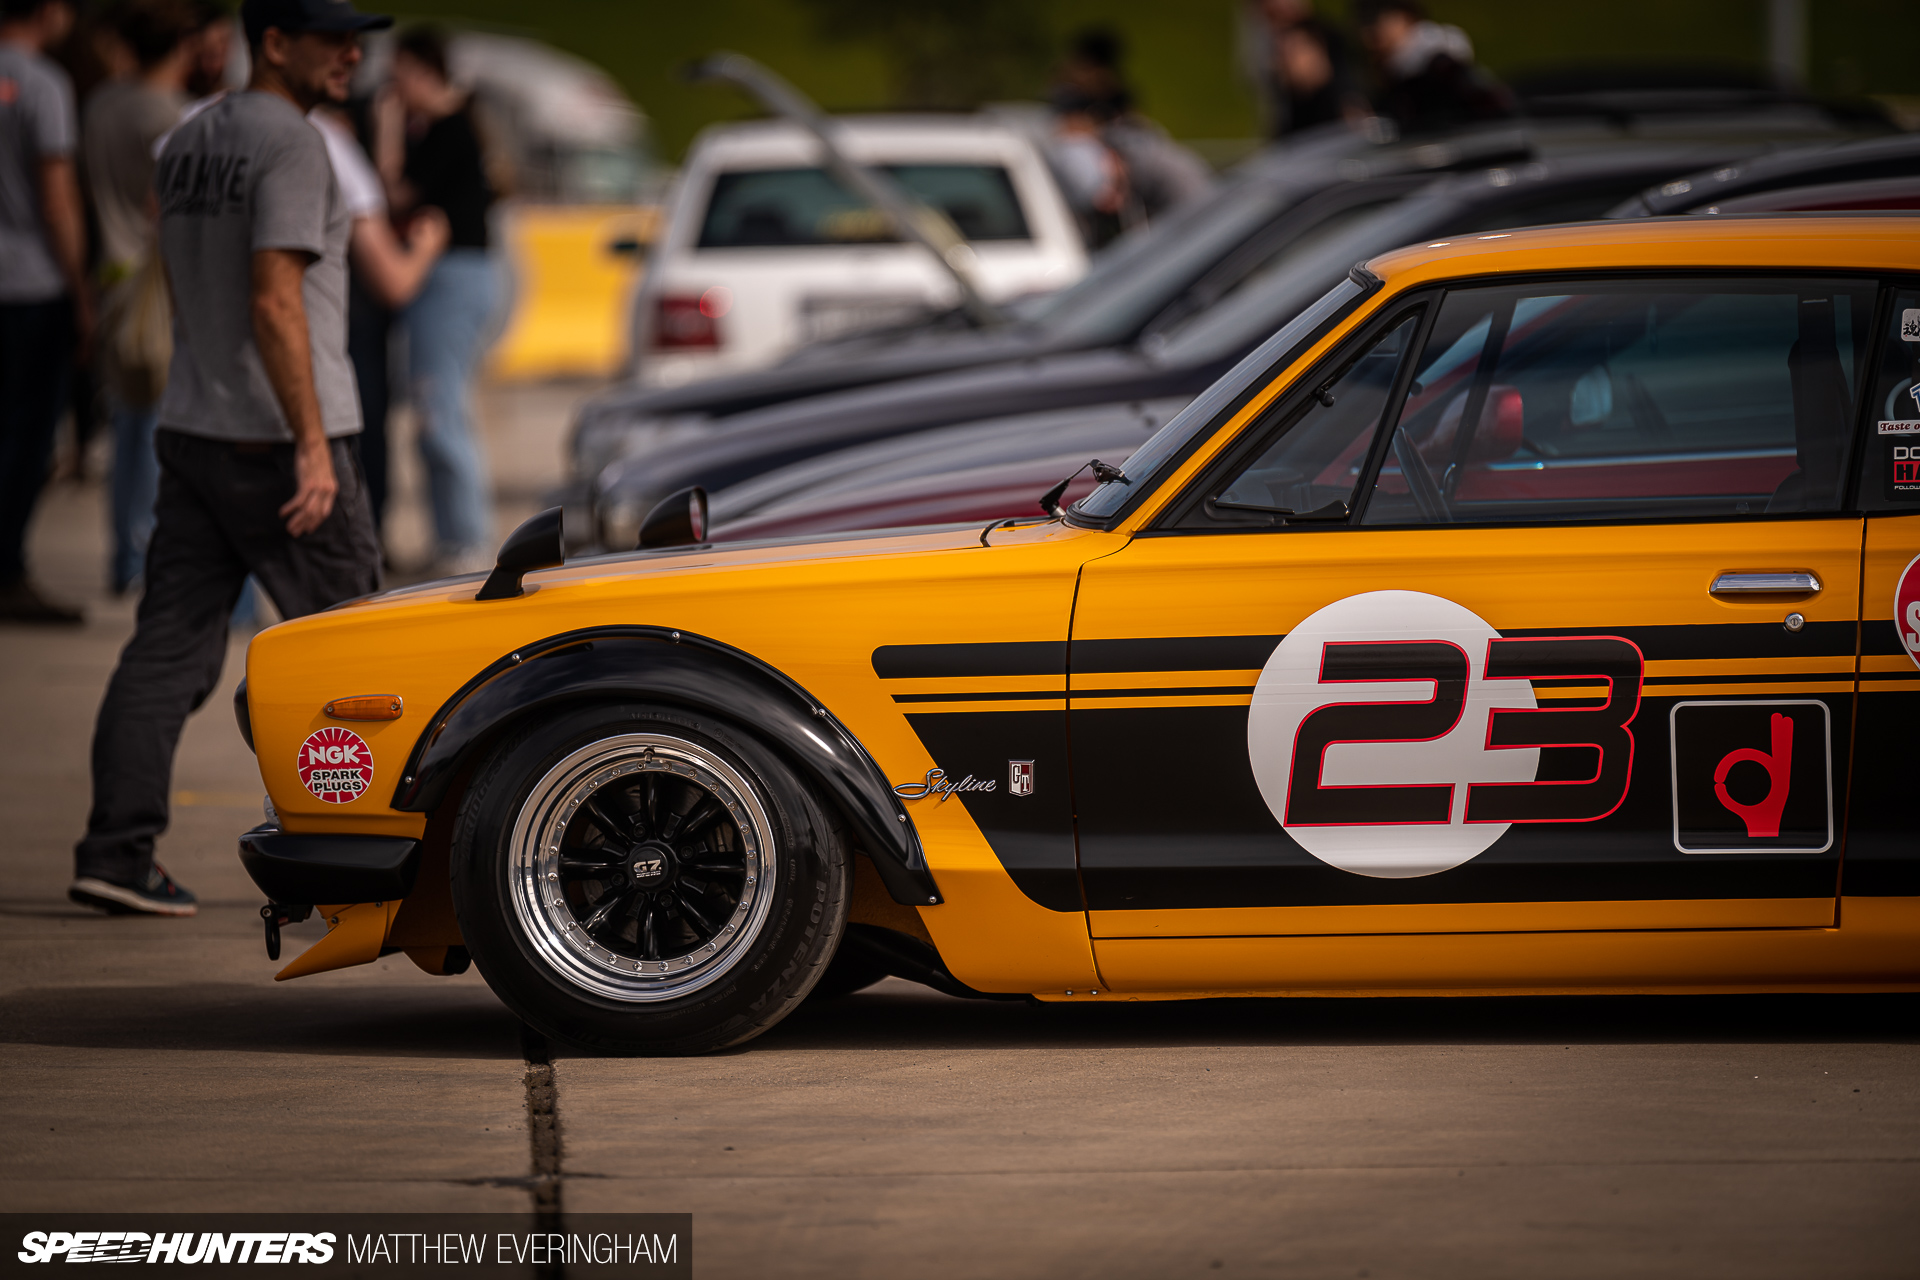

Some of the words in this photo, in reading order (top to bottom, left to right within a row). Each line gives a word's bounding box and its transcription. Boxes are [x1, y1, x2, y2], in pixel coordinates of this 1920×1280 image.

[1880, 422, 1911, 431] Taste
[1283, 635, 1645, 828] 23
[308, 744, 361, 765] NGK
[312, 769, 361, 781] SPARK
[313, 781, 362, 792] PLUGS
[893, 767, 997, 801] Skyline
[1012, 764, 1030, 792] GT
[749, 879, 828, 1013] POTENZA
